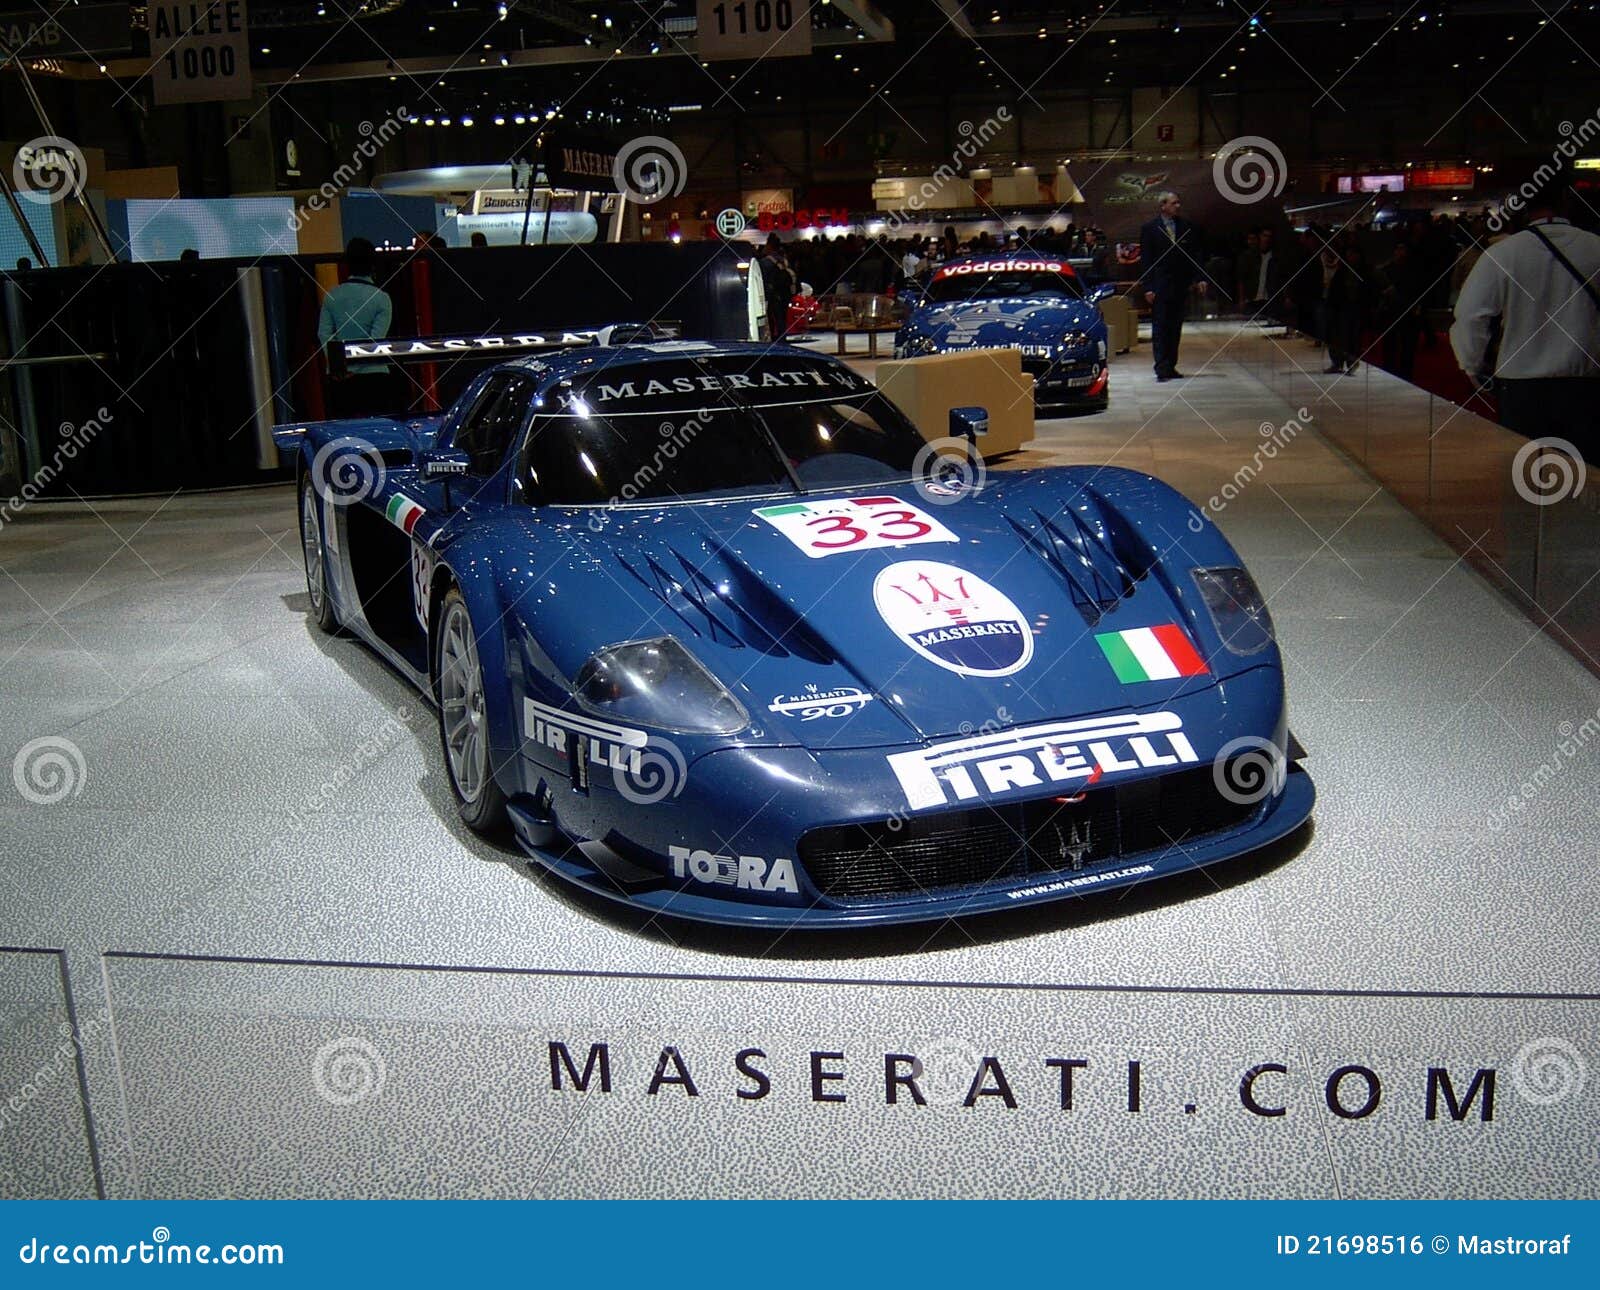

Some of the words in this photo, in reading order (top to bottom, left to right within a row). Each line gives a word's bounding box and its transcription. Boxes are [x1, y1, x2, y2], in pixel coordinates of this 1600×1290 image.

[155, 0, 241, 38] ALLEE
[713, 0, 792, 34] 1100
[167, 45, 235, 80] 1000
[758, 208, 848, 232] BOSCH
[943, 261, 1063, 277] vodafone
[347, 331, 600, 357] MASERAT
[598, 371, 830, 401] MASERATI
[806, 511, 932, 548] 33
[916, 622, 1020, 647] MASERATI
[789, 690, 847, 702] MASERATI
[801, 704, 853, 721] 90
[524, 696, 648, 775] PIRLLI
[886, 711, 1199, 811] PIRELLI
[1007, 864, 1154, 899] WWW.MASERATI.COM
